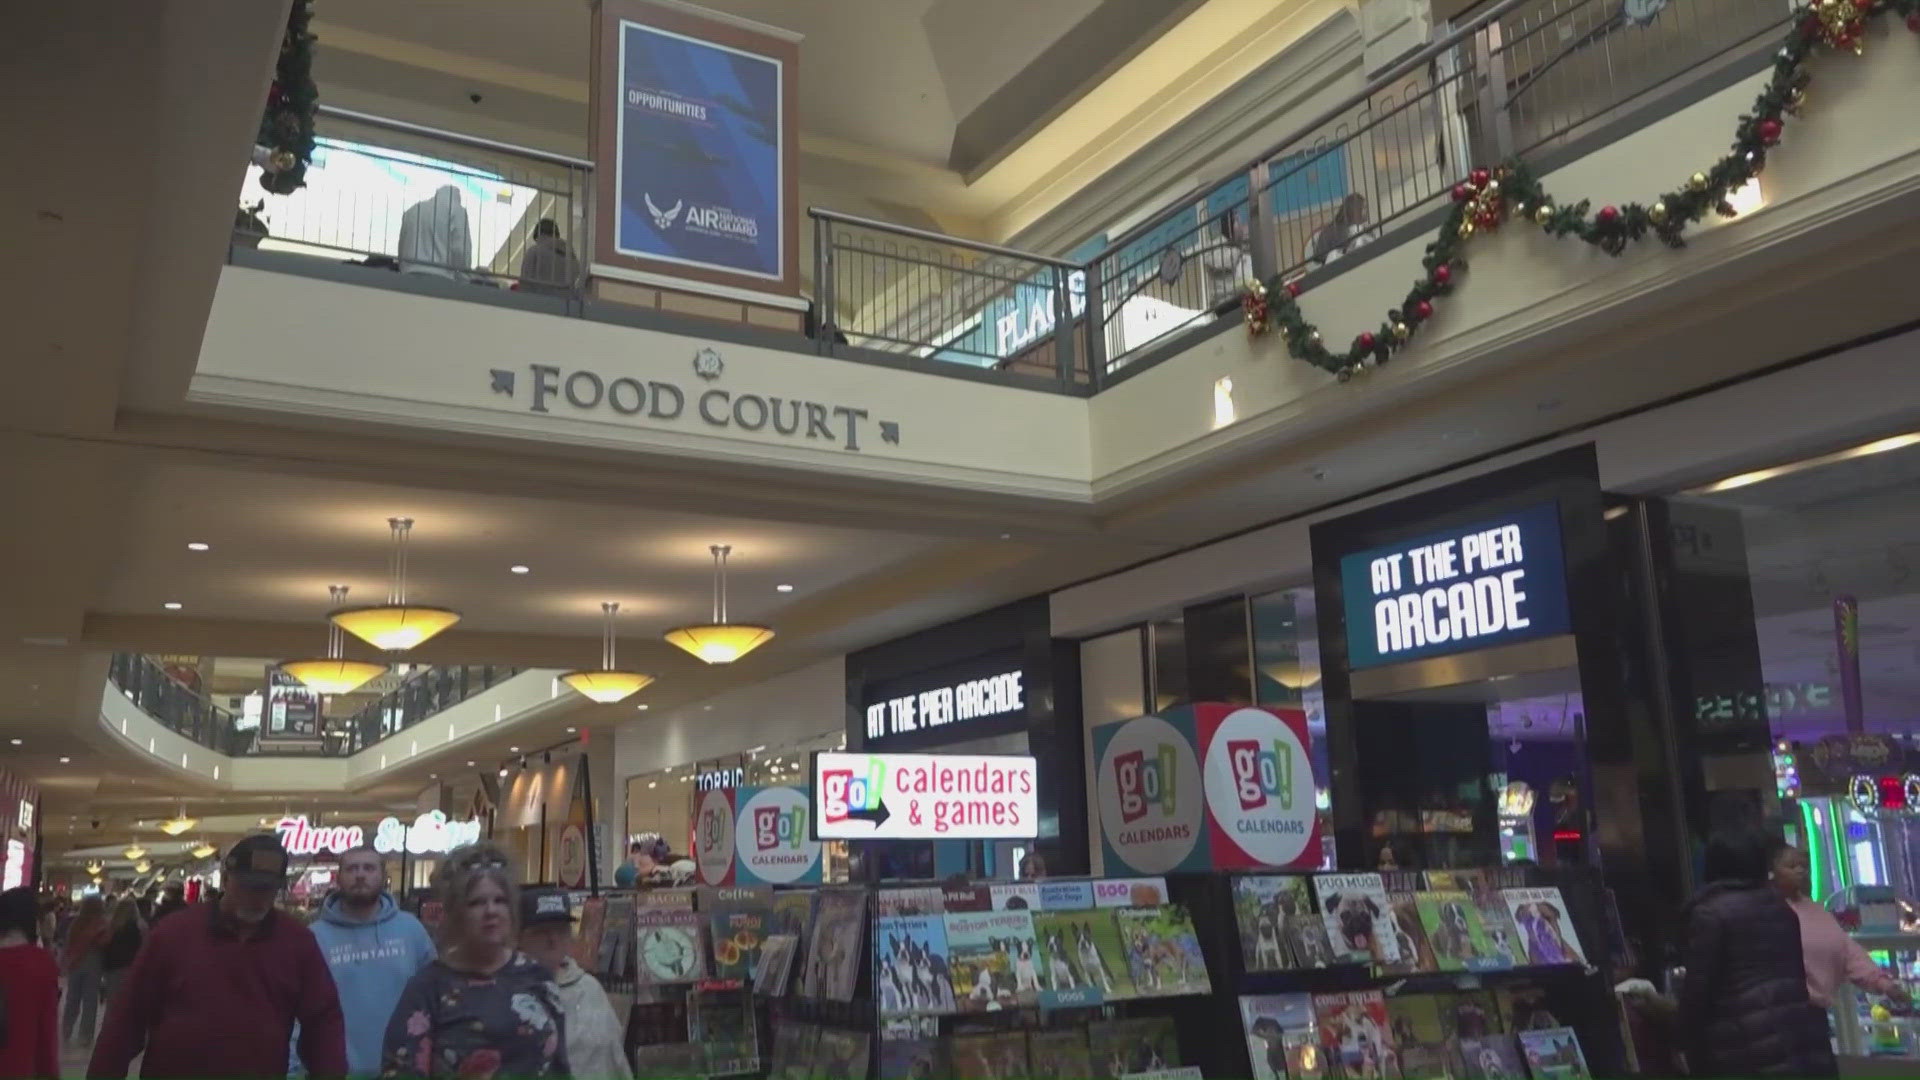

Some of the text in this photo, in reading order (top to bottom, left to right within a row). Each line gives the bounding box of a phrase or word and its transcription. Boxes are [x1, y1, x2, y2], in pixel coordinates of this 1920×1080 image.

[628, 89, 706, 121] OPPORTUNITIES
[686, 206, 719, 229] AIR
[530, 363, 868, 450] FOOD COURT
[1371, 524, 1523, 595] AT THE PIER
[1375, 569, 1530, 654] ARCADE
[867, 670, 1024, 739] AT THE PIER ARCADE
[896, 760, 1031, 794] calendars
[909, 800, 1019, 832] & games
[1237, 819, 1304, 834] CALENDARS
[276, 815, 363, 855] Three
[1119, 825, 1190, 846] CALENDARS
[752, 855, 808, 865] CALENDARS
[1097, 883, 1128, 897] BOO
[1318, 875, 1380, 891] PUG MUGS
